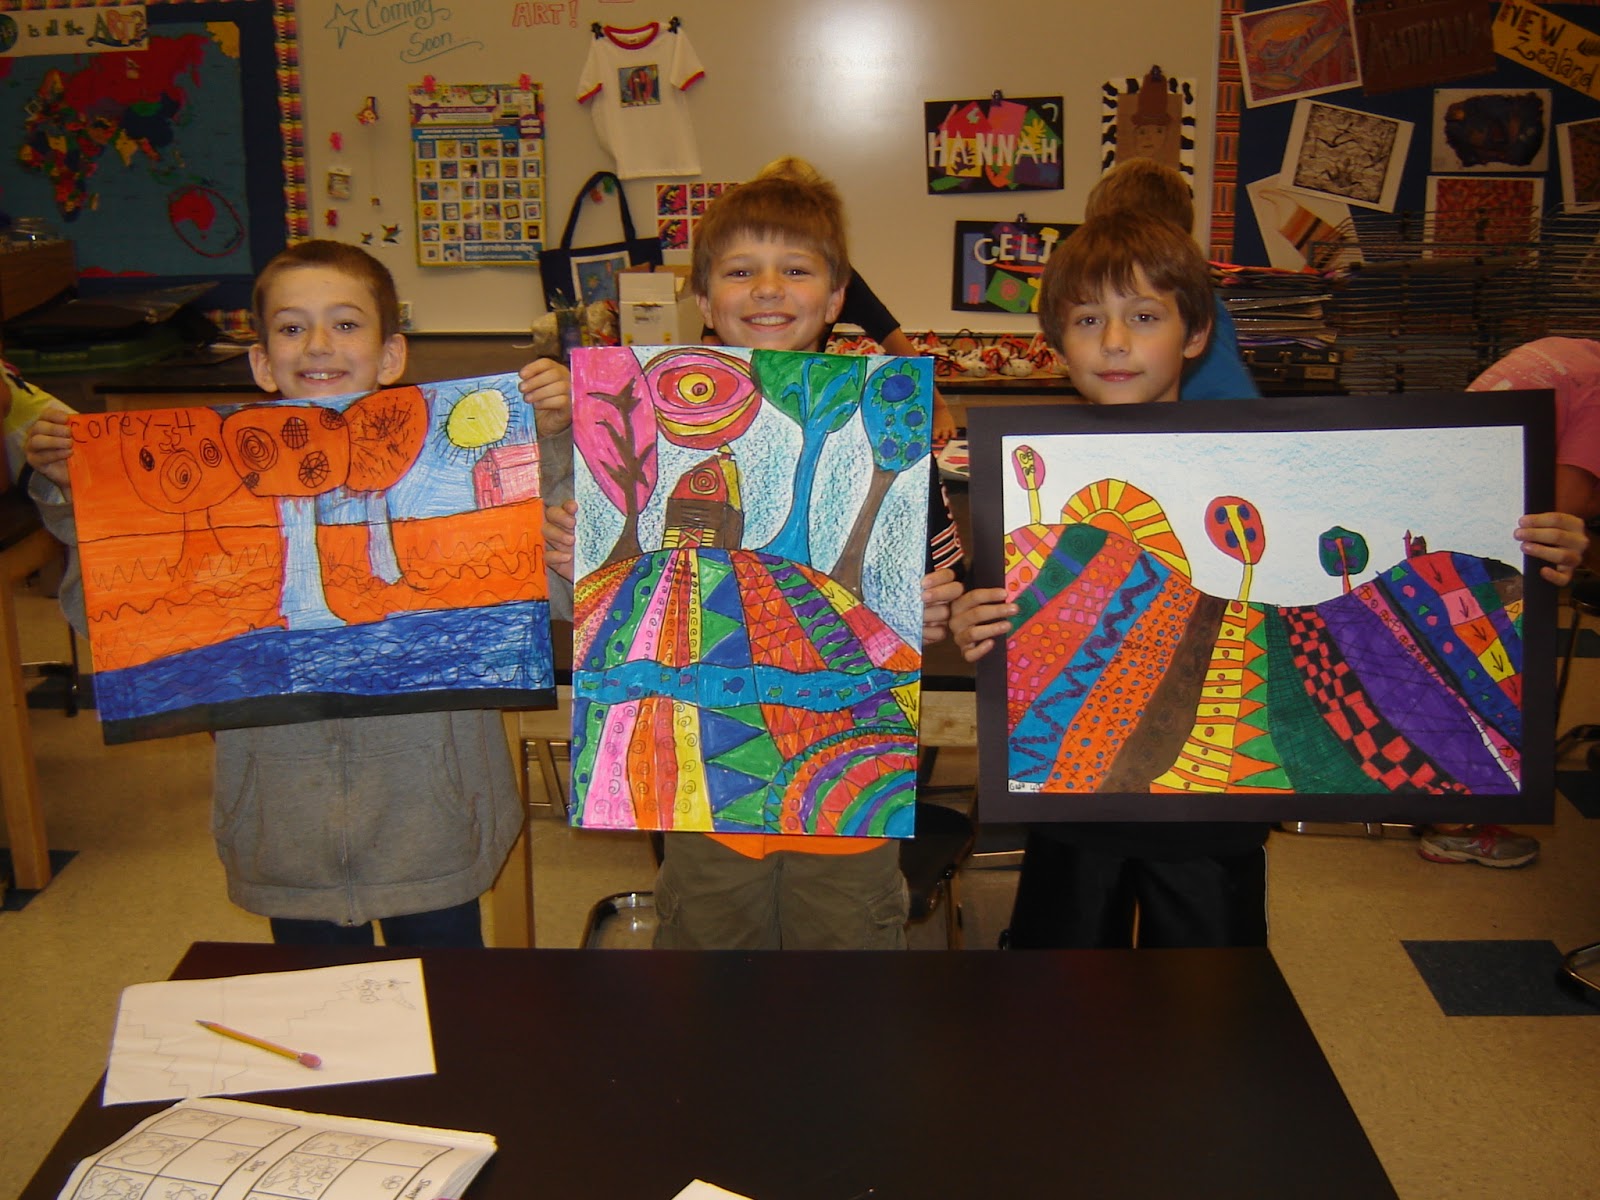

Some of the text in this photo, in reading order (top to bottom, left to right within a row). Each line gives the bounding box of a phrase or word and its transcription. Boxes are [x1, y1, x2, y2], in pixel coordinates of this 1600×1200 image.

[365, 0, 452, 30] Coming
[511, 0, 578, 28] ART!
[1497, 1, 1567, 47] NEW
[407, 32, 453, 57] Soon
[1507, 36, 1600, 92] Zealand
[928, 130, 1058, 168] HANNAH
